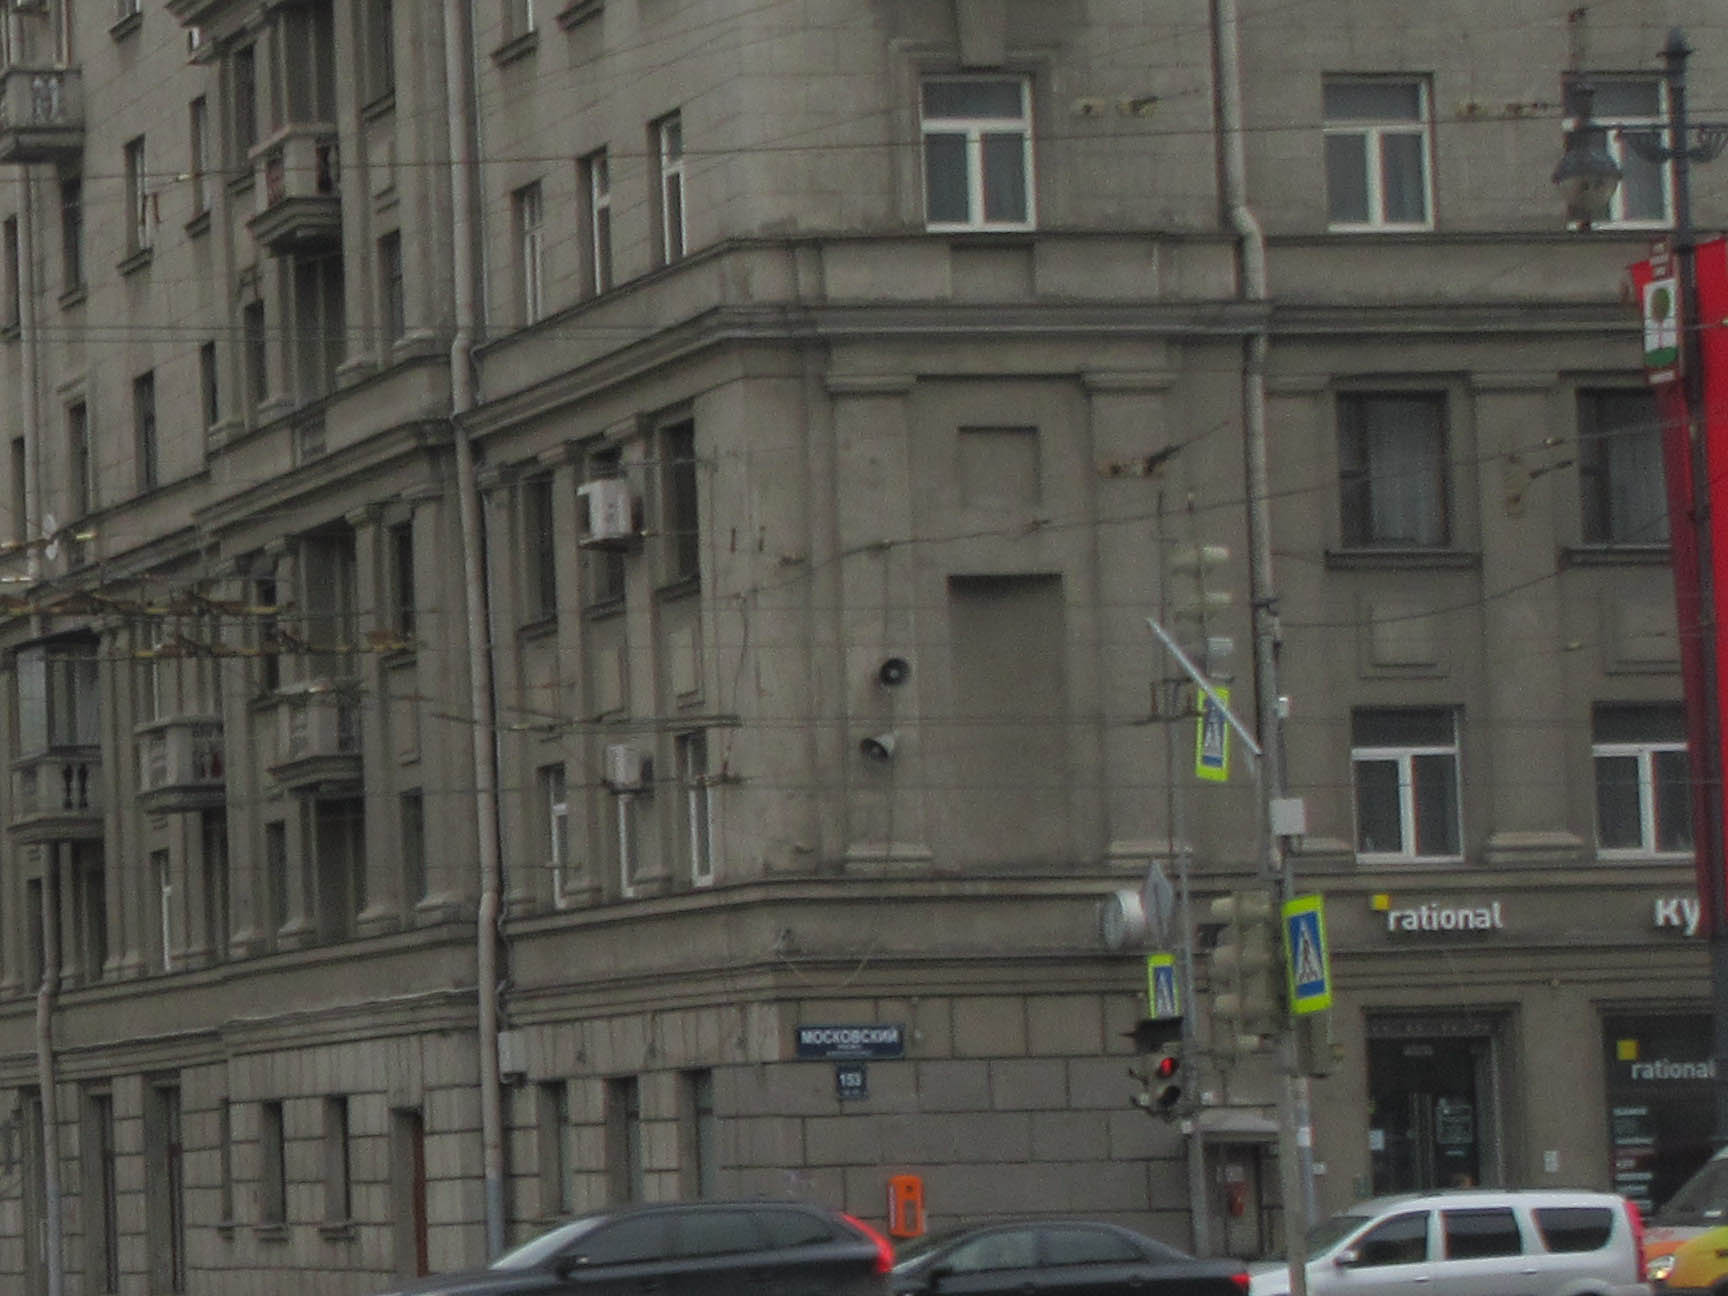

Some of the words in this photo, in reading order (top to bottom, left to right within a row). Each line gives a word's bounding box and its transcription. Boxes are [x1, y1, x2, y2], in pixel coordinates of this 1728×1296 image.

[1387, 901, 1504, 931] rational
[801, 1028, 898, 1044] МОСКОВСКИЙ
[1631, 1059, 1716, 1080] rational
